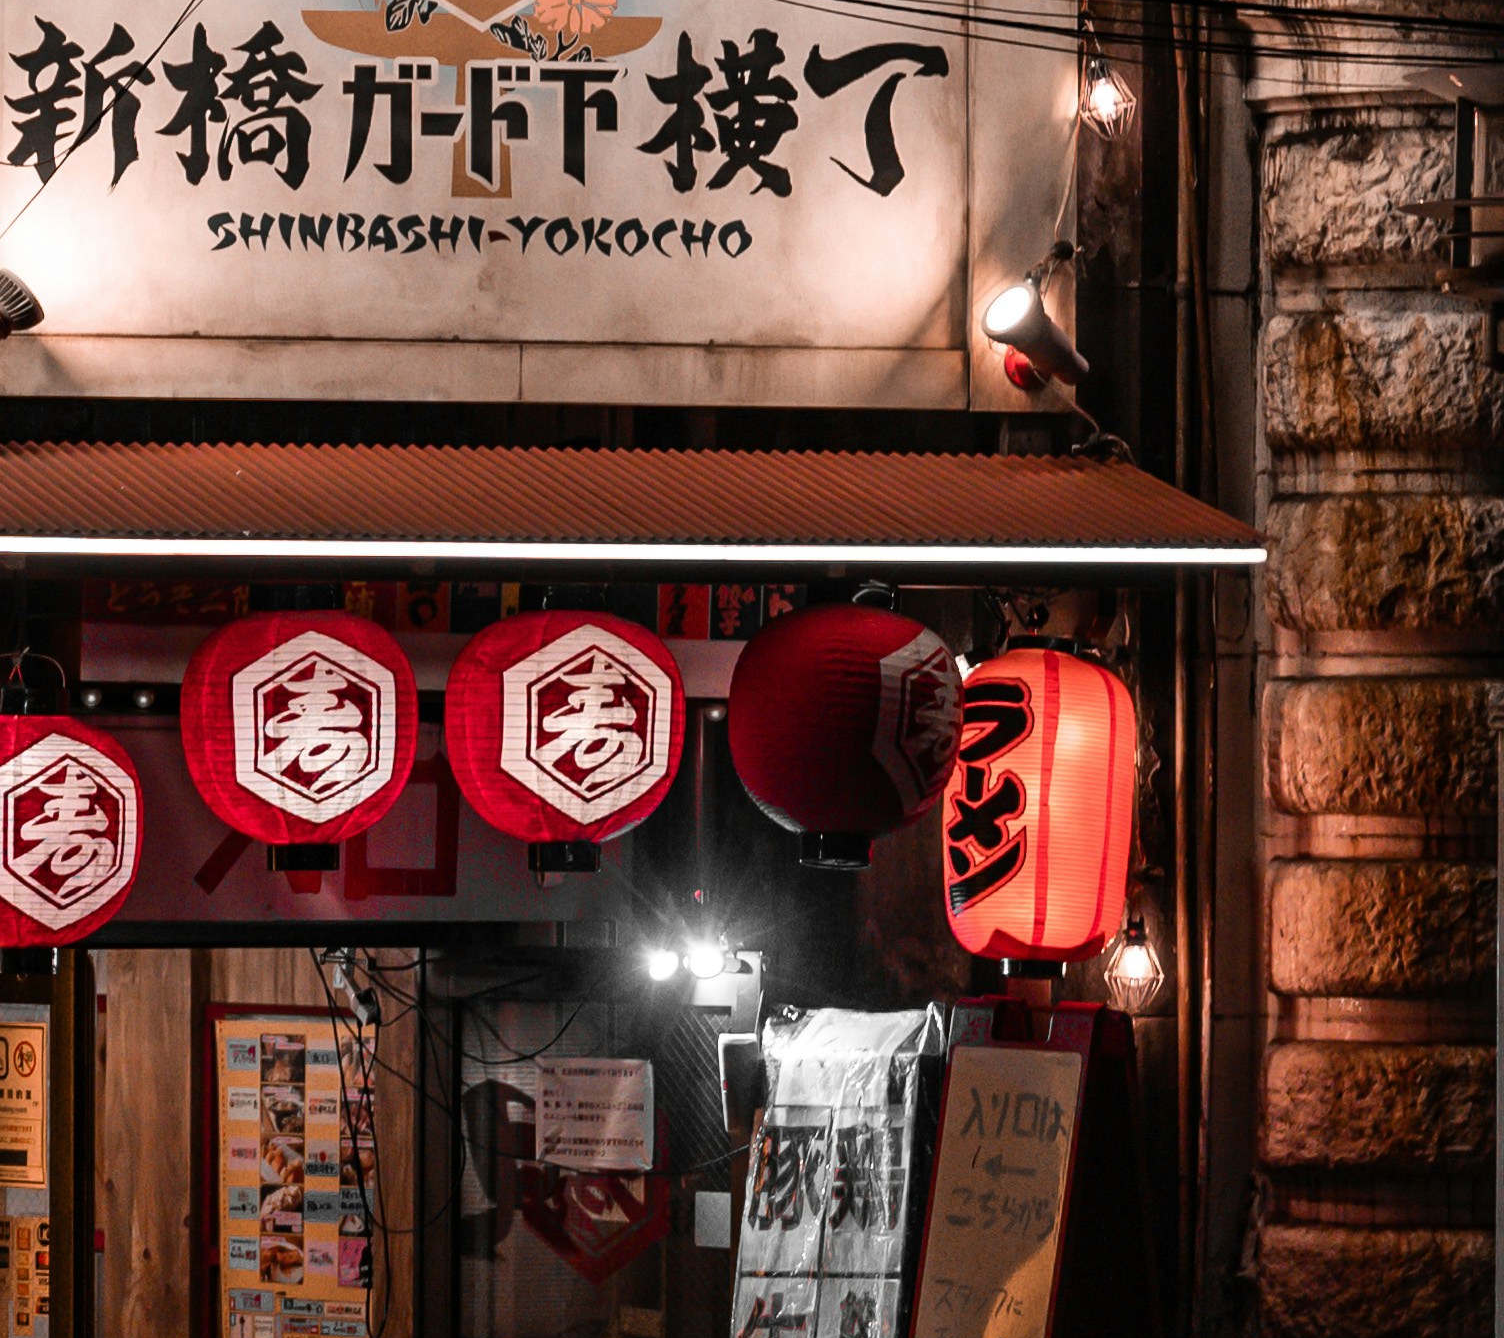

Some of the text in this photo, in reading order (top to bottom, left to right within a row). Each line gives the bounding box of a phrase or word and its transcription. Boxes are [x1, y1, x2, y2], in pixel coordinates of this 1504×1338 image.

[4, 15, 949, 197] 新橋ガード下横丁
[207, 212, 754, 259] SHINBASHI-YOKOCHO
[947, 677, 1033, 914] ラーメン
